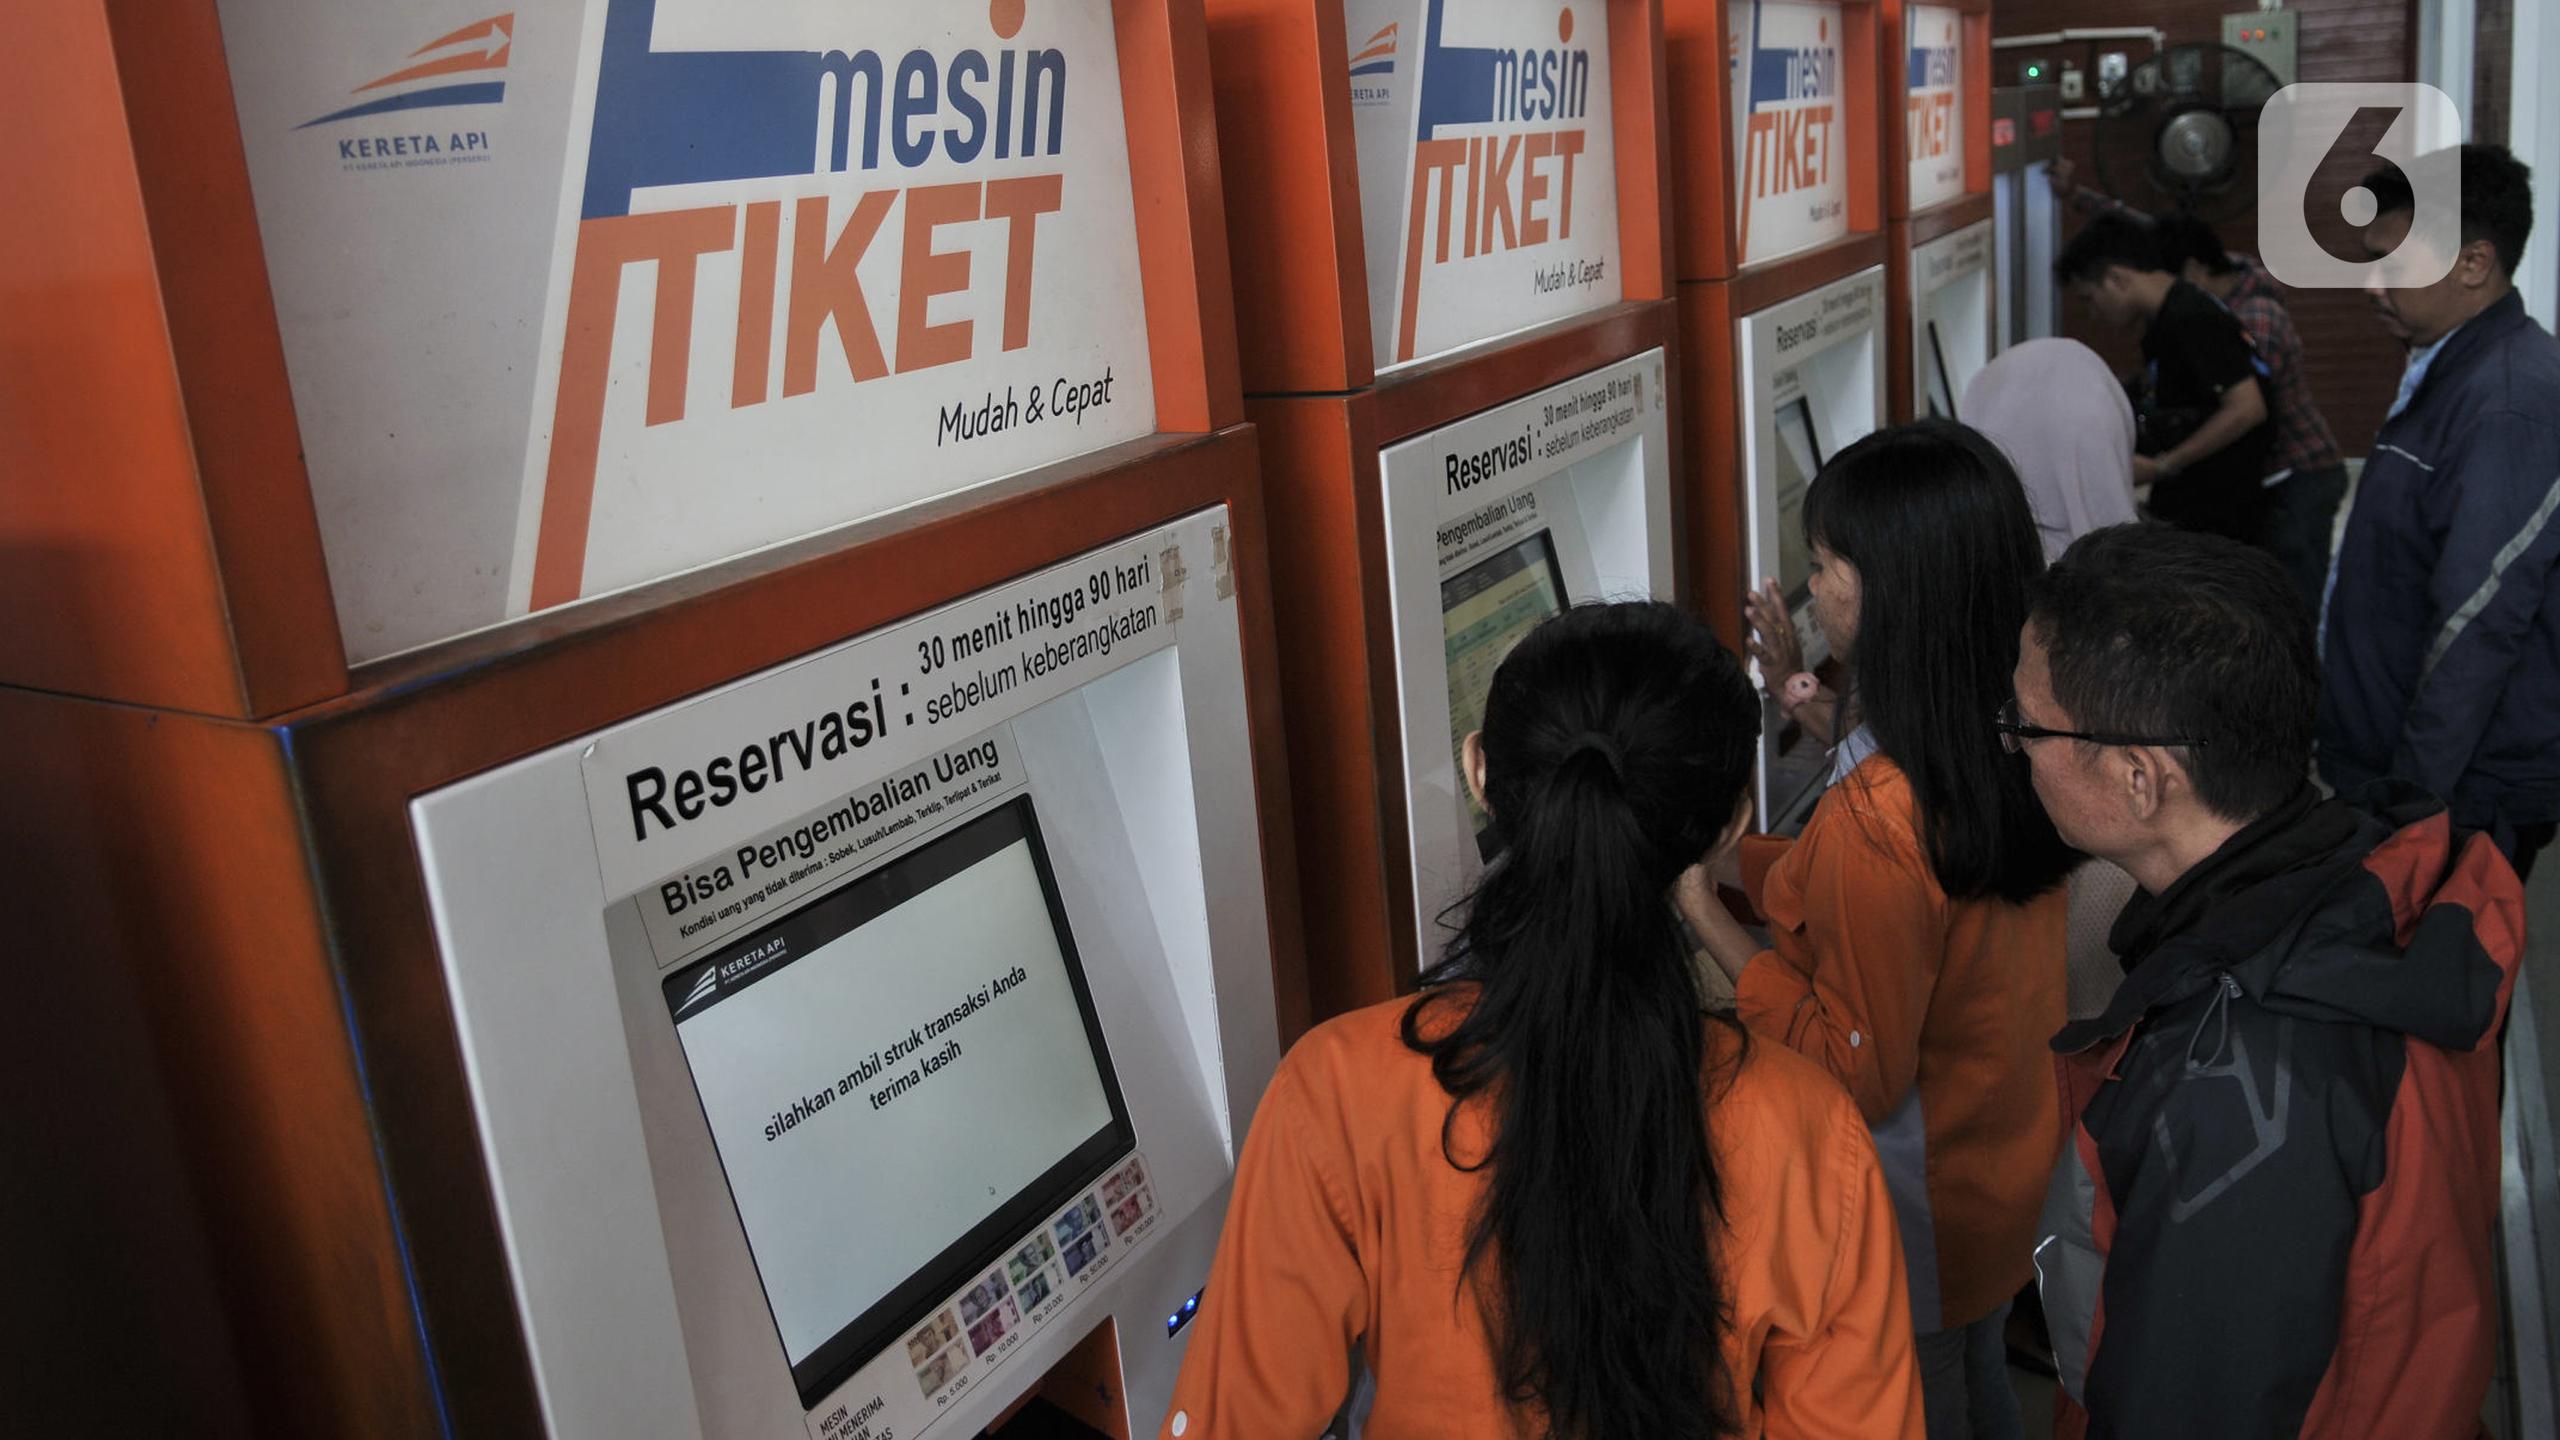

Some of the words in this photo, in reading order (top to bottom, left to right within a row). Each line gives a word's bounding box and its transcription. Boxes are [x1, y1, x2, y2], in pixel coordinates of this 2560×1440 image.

[813, 0, 1067, 173] mesin
[1493, 7, 1590, 122] mesin
[338, 135, 440, 159] KERETA
[450, 131, 489, 151] API
[1750, 105, 1833, 198] TIKET
[1417, 129, 1585, 264] TIKET
[580, 174, 1064, 428] TIKET
[1534, 261, 1565, 296] Mudah
[1578, 256, 1604, 292] Cepat
[938, 392, 1018, 446] Mudah
[1025, 387, 1045, 422] &
[1051, 367, 1114, 425] Cepat
[1445, 425, 1533, 495] Reservasi
[1508, 492, 1536, 514] Uang
[918, 635, 946, 675] 30
[951, 612, 1013, 662] menit
[1016, 588, 1086, 636] hingga
[1089, 570, 1111, 605] 90
[1115, 554, 1151, 595] hari
[926, 665, 1017, 725] sebelum
[1022, 604, 1157, 683] keberangkatan
[626, 677, 888, 842] Reservasi
[660, 866, 735, 917] Bisa
[737, 766, 932, 880] Pengembalian
[933, 739, 999, 783] Uang
[680, 909, 718, 939] Kondisi
[718, 900, 743, 920] uang
[742, 889, 766, 911] yang
[765, 876, 789, 896] tidak
[789, 860, 824, 884] diterima
[828, 843, 858, 864] Sobek,
[720, 948, 766, 978] KERETA
[767, 936, 785, 954] API
[763, 1087, 836, 1142] silahkan
[837, 1052, 883, 1096] ambil
[883, 1028, 924, 1066] struk
[923, 984, 991, 1041] transaksi
[992, 965, 1028, 1000] Anda
[869, 1070, 921, 1110] terima
[920, 1039, 963, 1080] kasih
[820, 1404, 849, 1436] MESIN
[838, 1395, 885, 1439] MENERIMA
[949, 1375, 969, 1396] 5.000
